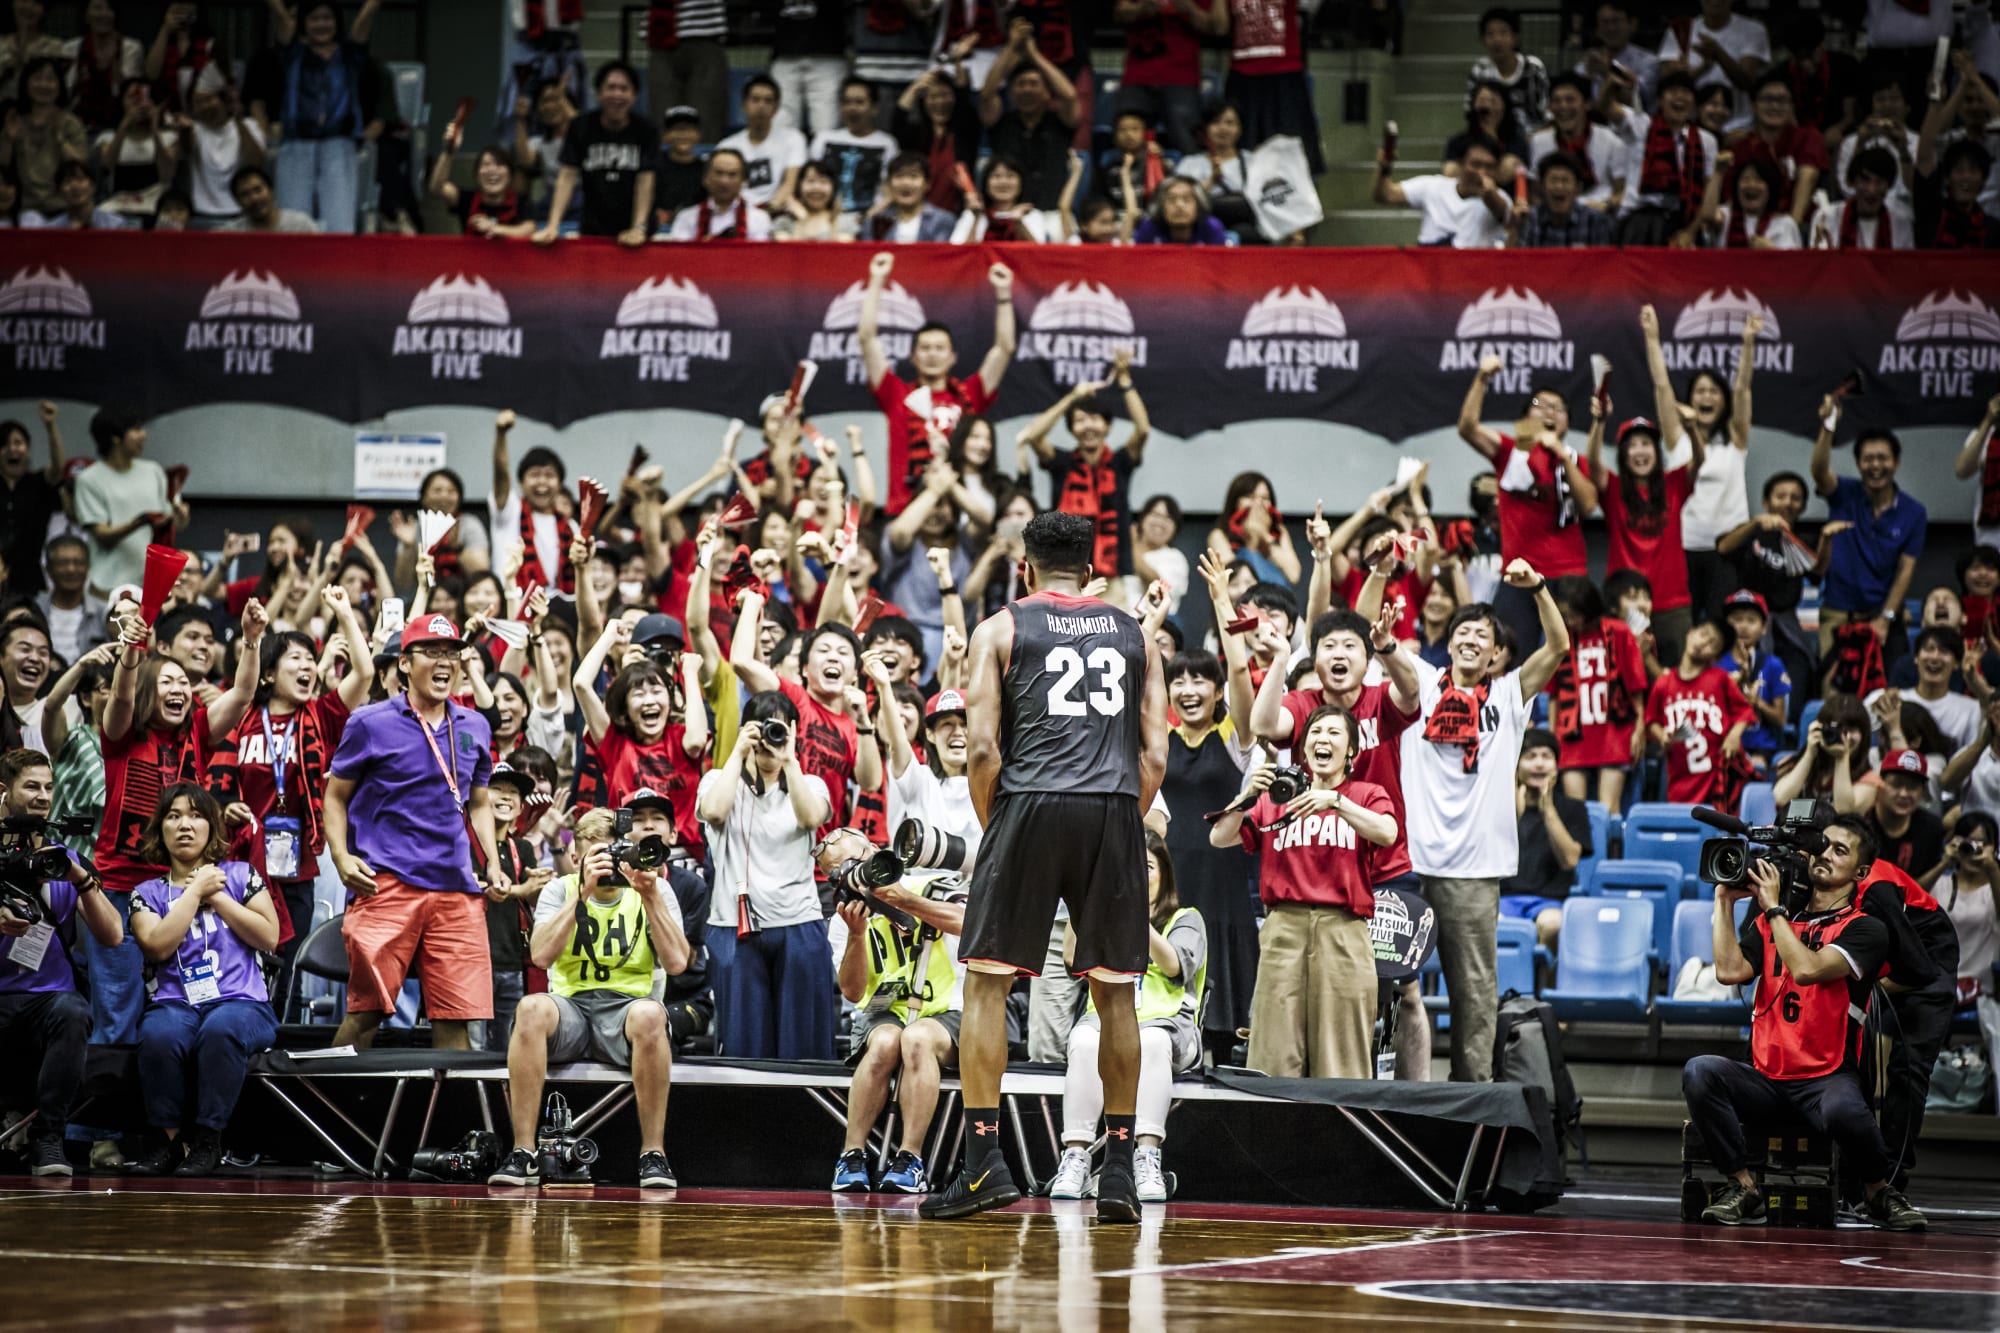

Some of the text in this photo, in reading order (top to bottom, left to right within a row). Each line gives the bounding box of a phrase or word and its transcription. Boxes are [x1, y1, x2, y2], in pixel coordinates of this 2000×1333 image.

[0, 319, 106, 347] KATSUKI
[185, 322, 314, 352] AKATSUKI
[392, 325, 523, 357] AKATSUKI
[599, 328, 732, 361] AKATSUKI
[15, 345, 65, 370] FIVE
[224, 348, 274, 375] FIVE
[431, 351, 482, 380] FIVE
[638, 353, 690, 382] FIVE
[1225, 339, 1359, 370] AKATSUKI
[1879, 344, 2000, 373] AKATSUK
[1266, 365, 1318, 392] FIVE
[1488, 367, 1533, 394] IVE
[1921, 371, 1973, 397] FIVE
[1046, 613, 1118, 636] HACHIMURA
[1577, 646, 1608, 679] ET
[1045, 646, 1126, 717] 23
[1580, 681, 1608, 725] 10
[237, 733, 299, 767] JAPA
[1685, 732, 1712, 774] 2
[1273, 814, 1356, 852] JAPAN
[1370, 927, 1394, 943] FIVE
[580, 959, 610, 982] 18
[1782, 991, 1801, 1023] 6
